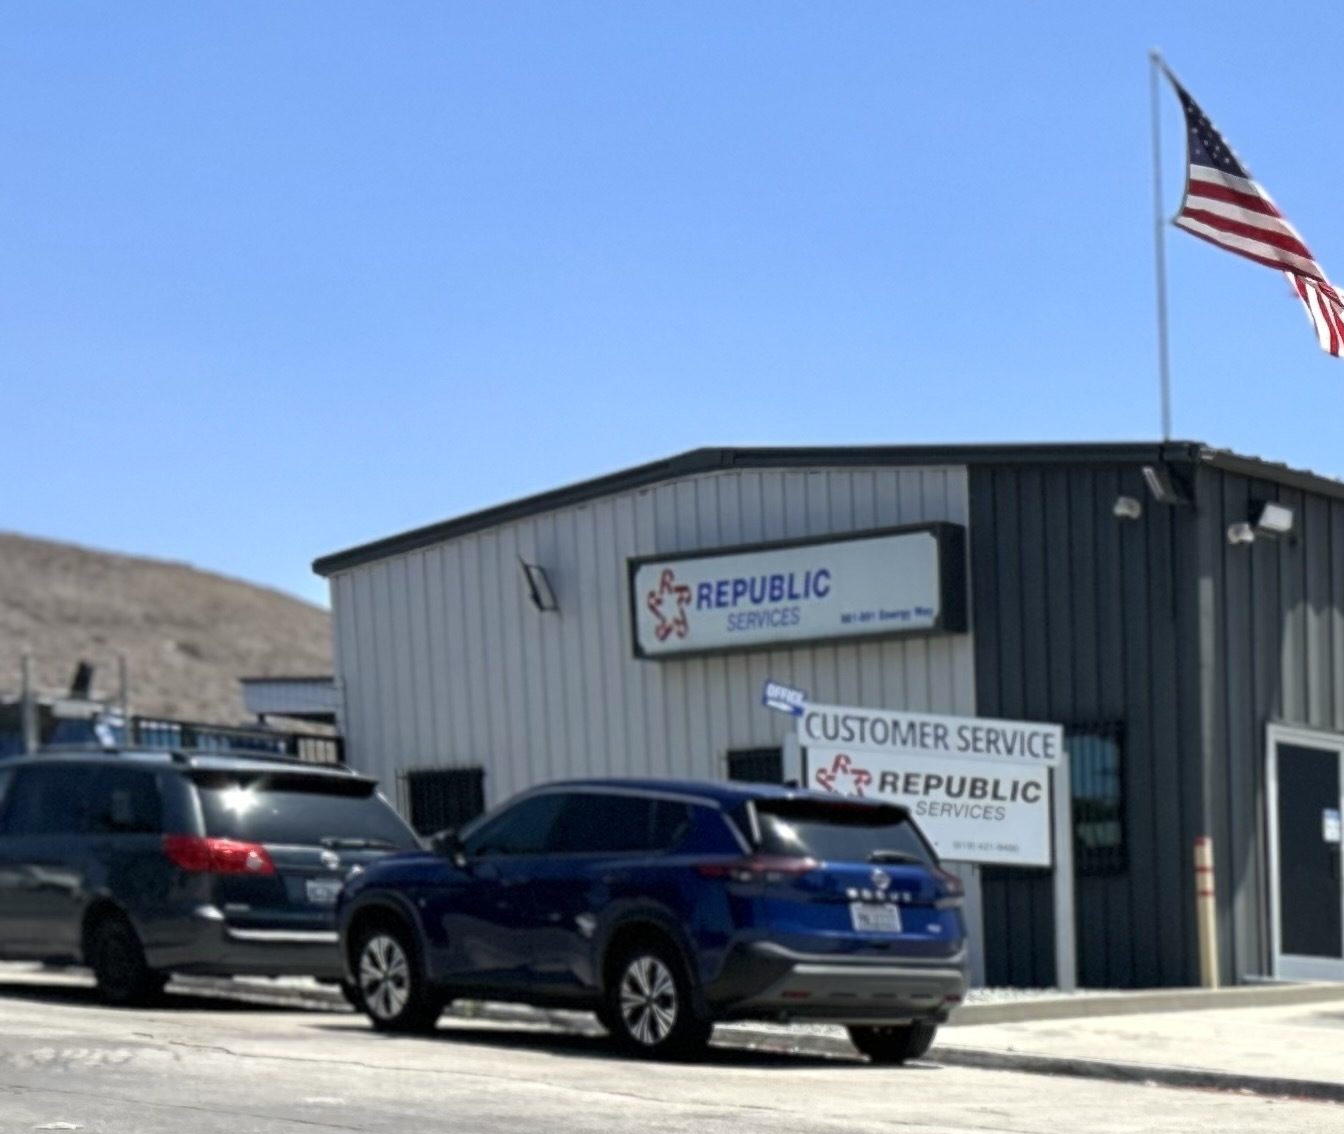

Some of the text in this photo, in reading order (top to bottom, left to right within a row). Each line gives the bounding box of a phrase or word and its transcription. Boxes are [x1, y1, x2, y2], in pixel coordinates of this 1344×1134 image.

[696, 569, 831, 610] REPUBLIC
[727, 607, 800, 632] SERVICES
[805, 712, 1055, 759] CUSTOMER SERVICE
[878, 771, 1042, 804] REPUBLIC
[916, 800, 1006, 821] SERVICES
